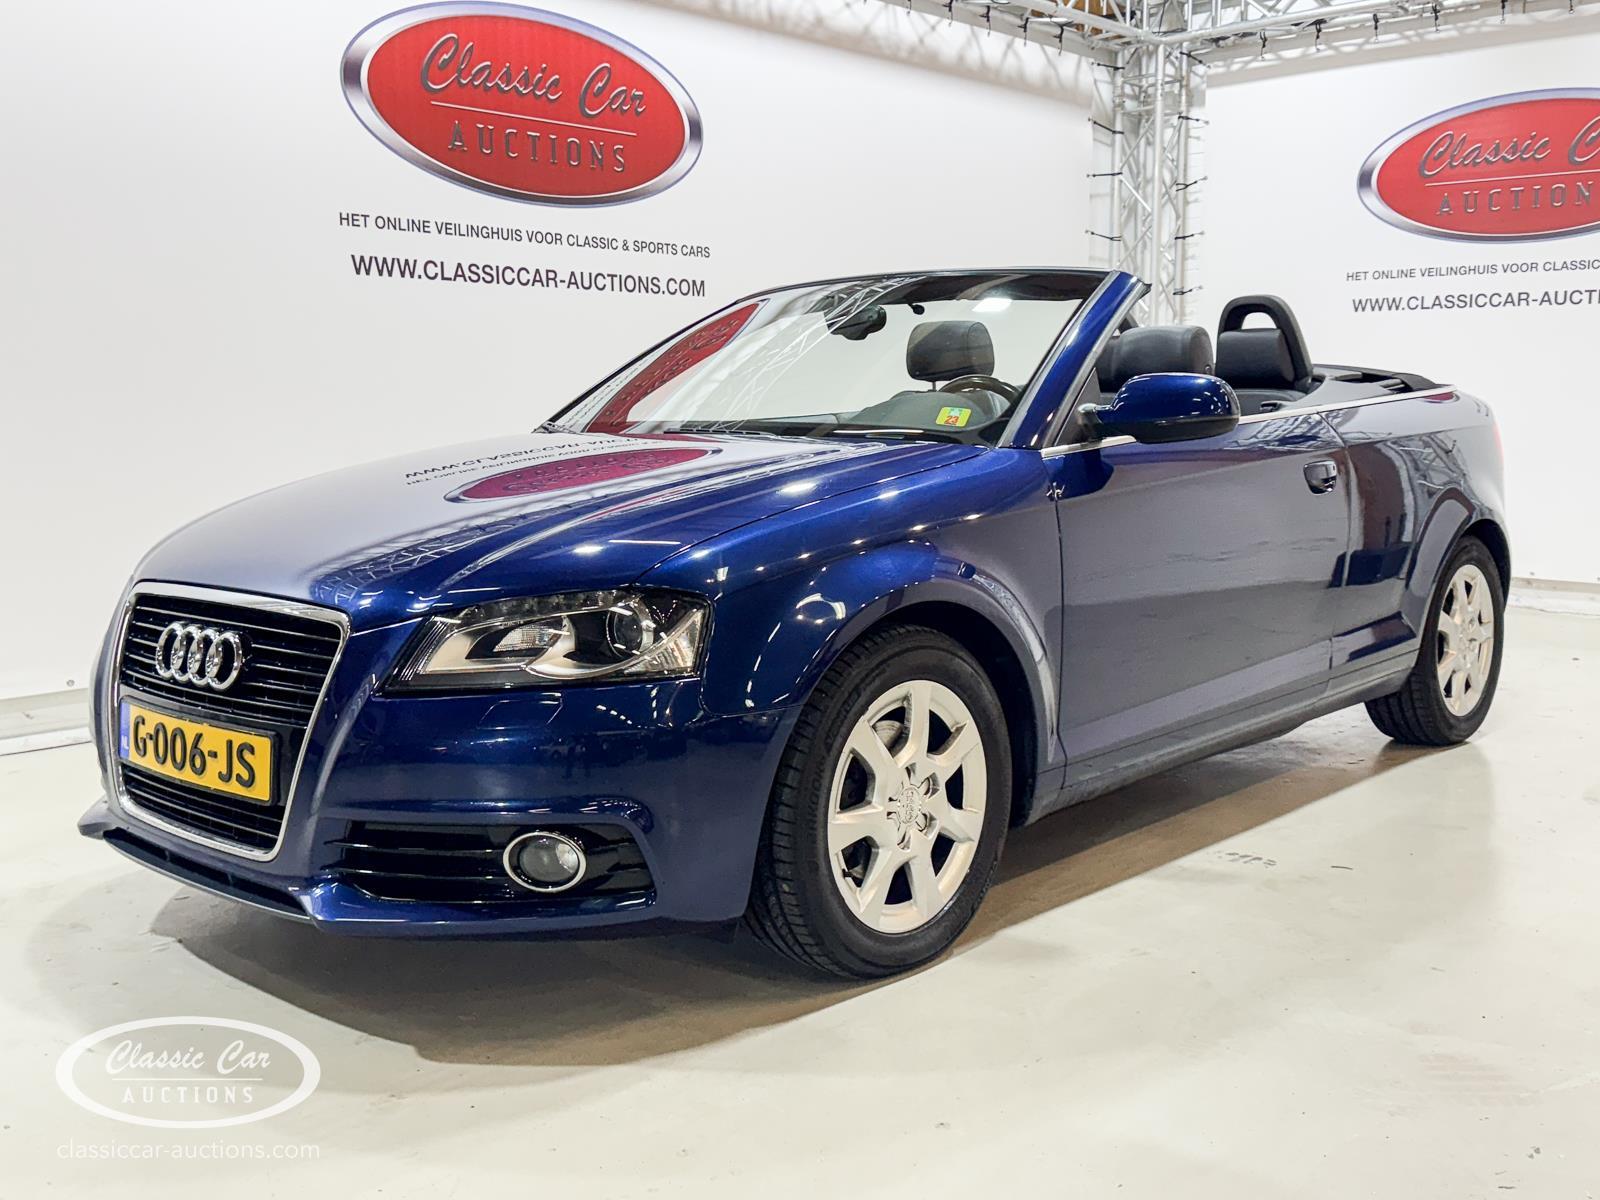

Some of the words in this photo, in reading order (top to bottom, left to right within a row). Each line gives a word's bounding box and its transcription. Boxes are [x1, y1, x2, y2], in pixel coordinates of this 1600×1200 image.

[421, 33, 562, 101] Classic
[579, 63, 646, 118] Car
[448, 120, 626, 173] AUCTIONS
[1419, 131, 1551, 178] Classic
[1437, 181, 1593, 215] AUCTION
[339, 212, 370, 228] HET
[374, 215, 431, 234] ONLINE
[434, 221, 523, 242] VEILINGHUIS
[526, 230, 563, 246] VOOR
[566, 234, 619, 250] CLASSIC
[622, 239, 630, 252] &
[632, 240, 678, 255] SPORTS
[681, 244, 711, 258] CARS
[351, 254, 706, 297] WWW.CLASSICCAR-AUCTIONS.COM
[1346, 271, 1368, 281] HET
[1372, 268, 1416, 280] ONLINE
[1420, 263, 1498, 278] VEILINGHUIS
[1502, 262, 1539, 274] VOOR
[1352, 288, 1600, 313] WWW.CLASSICCAR-AUCTI
[133, 714, 256, 789] G-006-JS
